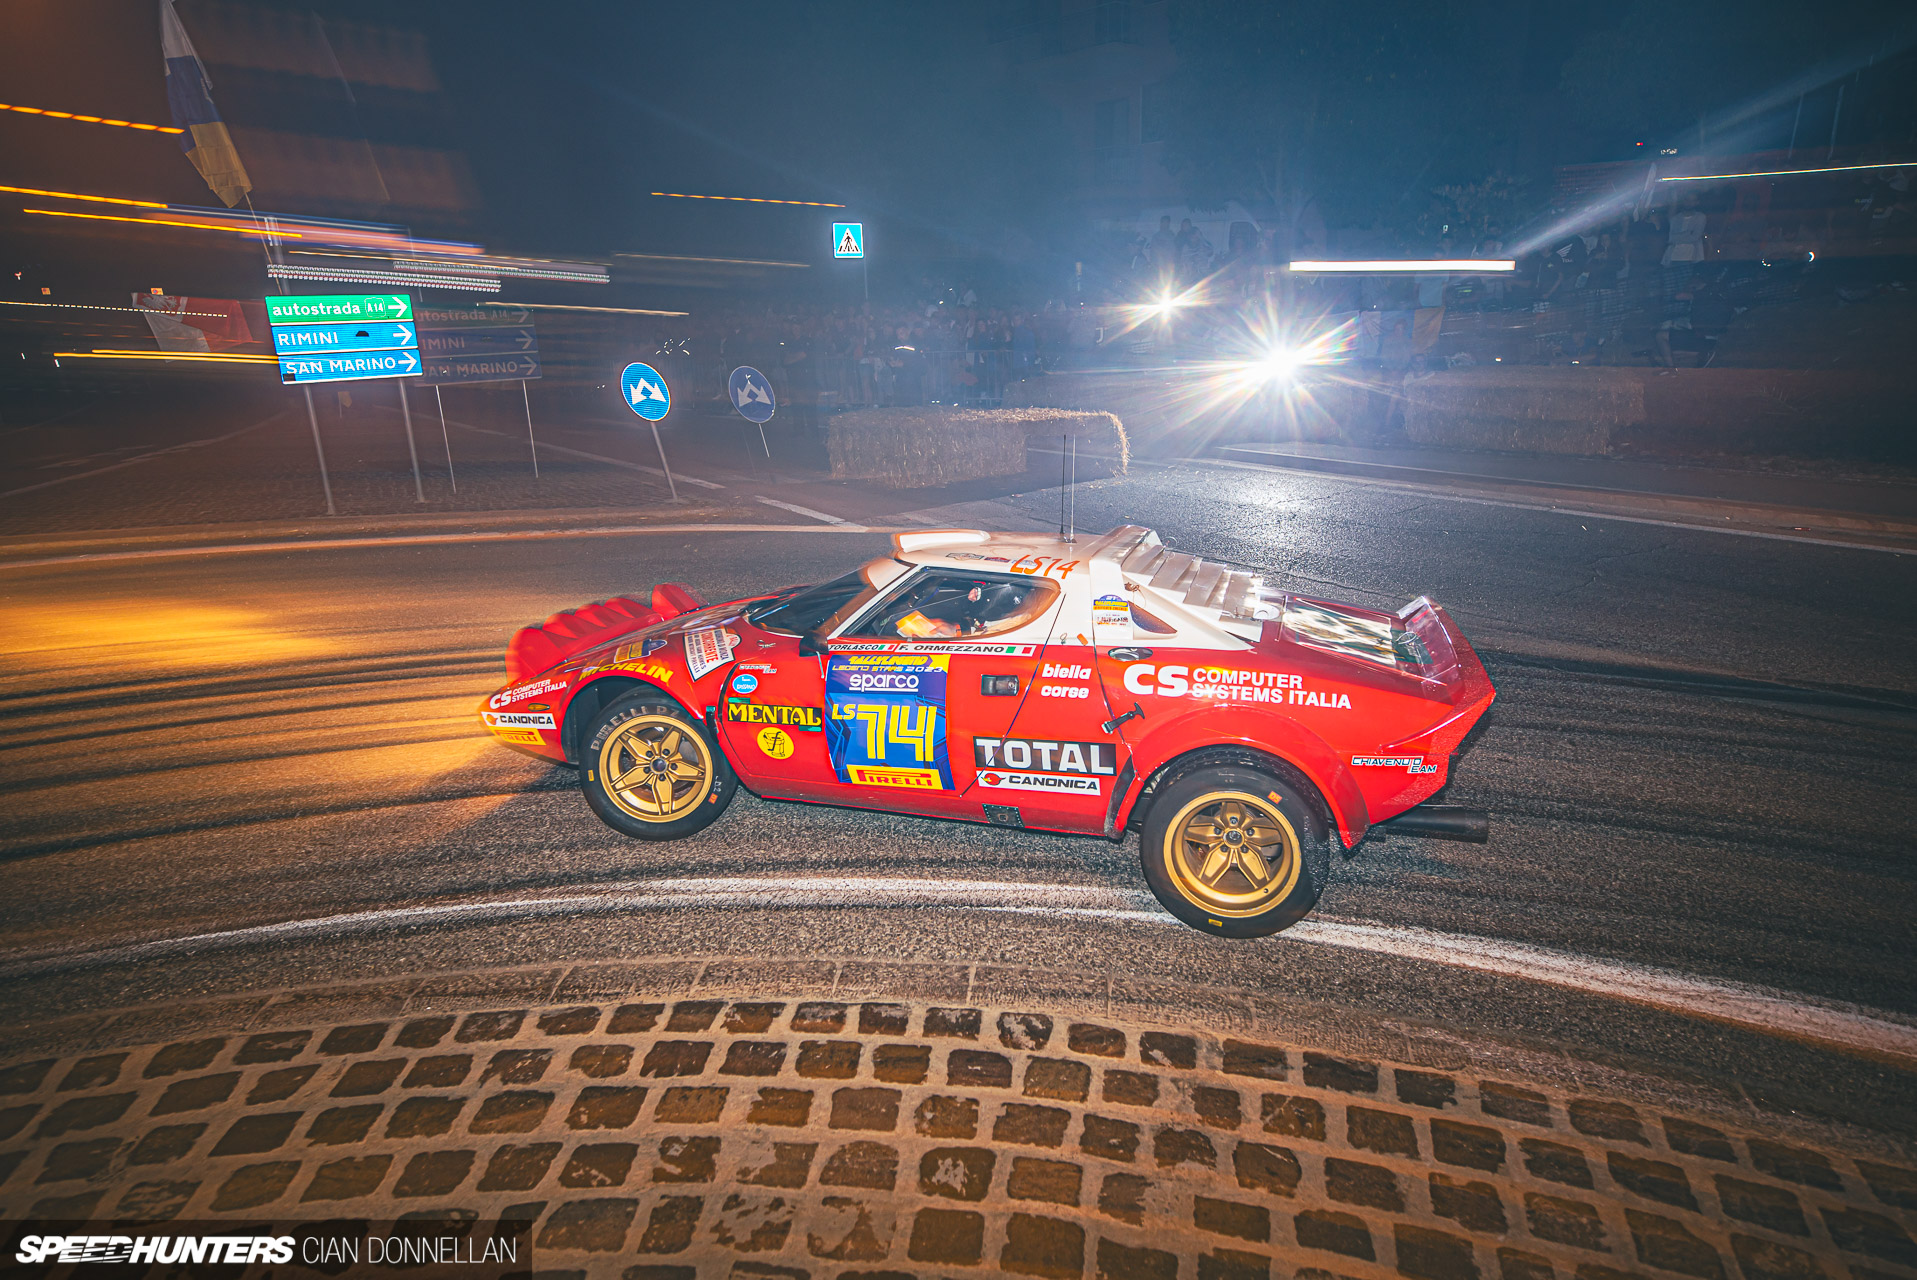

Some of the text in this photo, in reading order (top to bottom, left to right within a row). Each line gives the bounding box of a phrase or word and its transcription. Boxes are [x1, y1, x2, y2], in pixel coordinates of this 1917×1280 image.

[272, 302, 384, 317] autostrada A14
[278, 331, 339, 346] RIMINI
[421, 336, 465, 350] IMINI
[286, 357, 397, 375] SAN MARINO
[456, 361, 518, 376] MARINO
[913, 645, 1005, 653] ORMEZZANO
[578, 663, 673, 683] MICHELIN
[1041, 663, 1092, 680] biella
[1123, 663, 1189, 697] CS
[1192, 667, 1303, 689] COMPUTER
[512, 679, 551, 696] COMPUTER
[849, 673, 920, 692] sparco
[489, 690, 512, 710] CS
[511, 681, 568, 703] SYSTEMS ITALIA
[1041, 685, 1090, 699] corse
[1192, 682, 1352, 710] SYSTEMS ITALIA
[499, 715, 553, 725] CANONICA
[728, 703, 822, 726] MENTAL
[831, 703, 938, 762] LS 74
[975, 738, 1114, 775] TOTAL
[856, 769, 933, 787] PIRELLI
[1008, 775, 1098, 791] CANONICA
